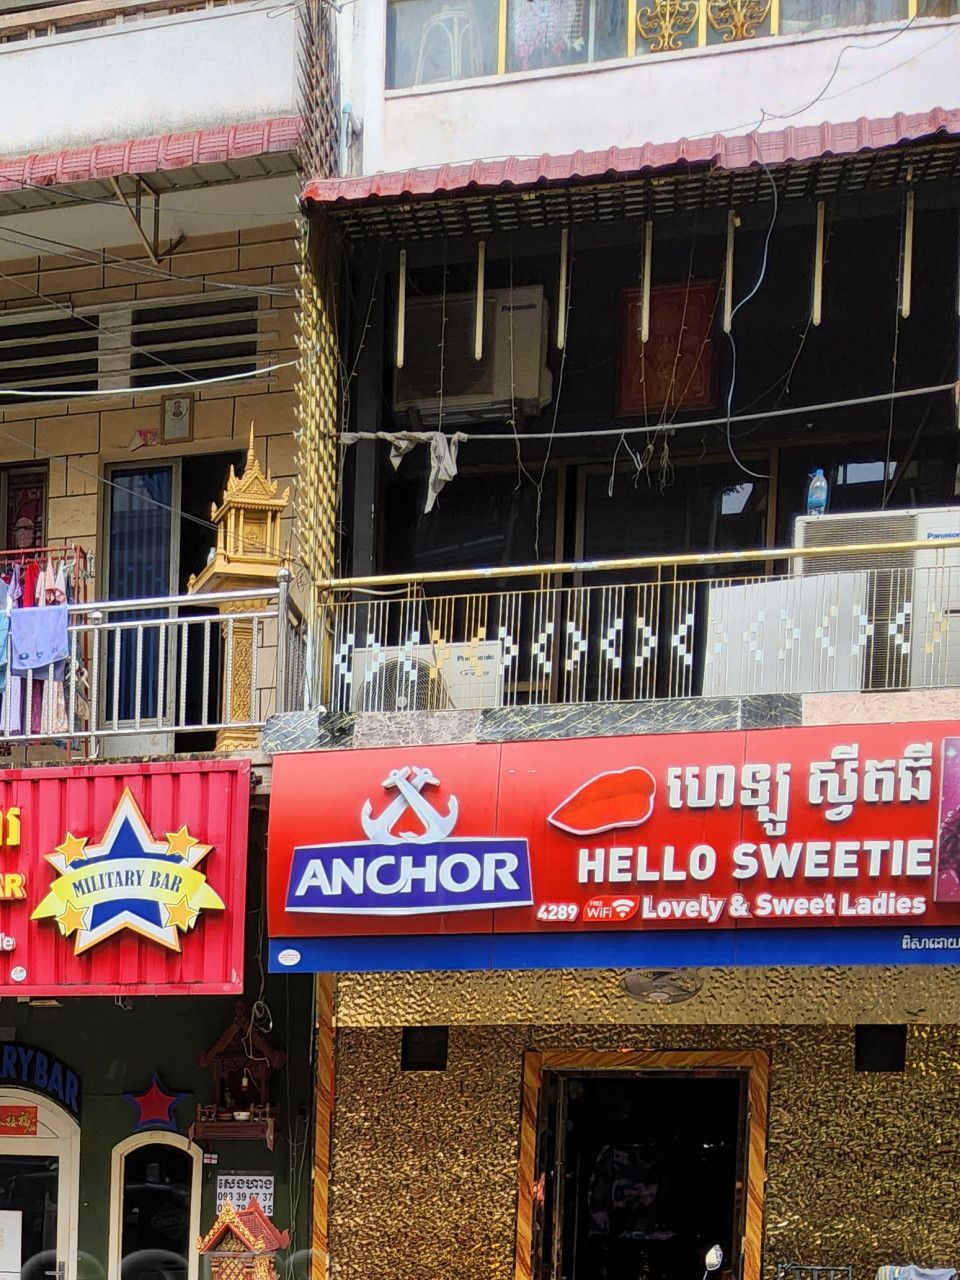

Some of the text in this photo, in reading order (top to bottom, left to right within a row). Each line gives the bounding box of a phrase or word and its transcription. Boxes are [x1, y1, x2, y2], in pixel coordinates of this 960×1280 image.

[294, 852, 520, 896] ANCHOR
[577, 839, 933, 884] HELLO SWEETIE
[72, 869, 183, 898] MILITARY BAR
[537, 904, 578, 921] 4289
[586, 907, 613, 918] WiFi
[642, 892, 927, 923] Lovely & Sweet Ladies
[218, 1192, 233, 1201] 093
[236, 1192, 247, 1201] 39
[262, 1192, 273, 1201] 37
